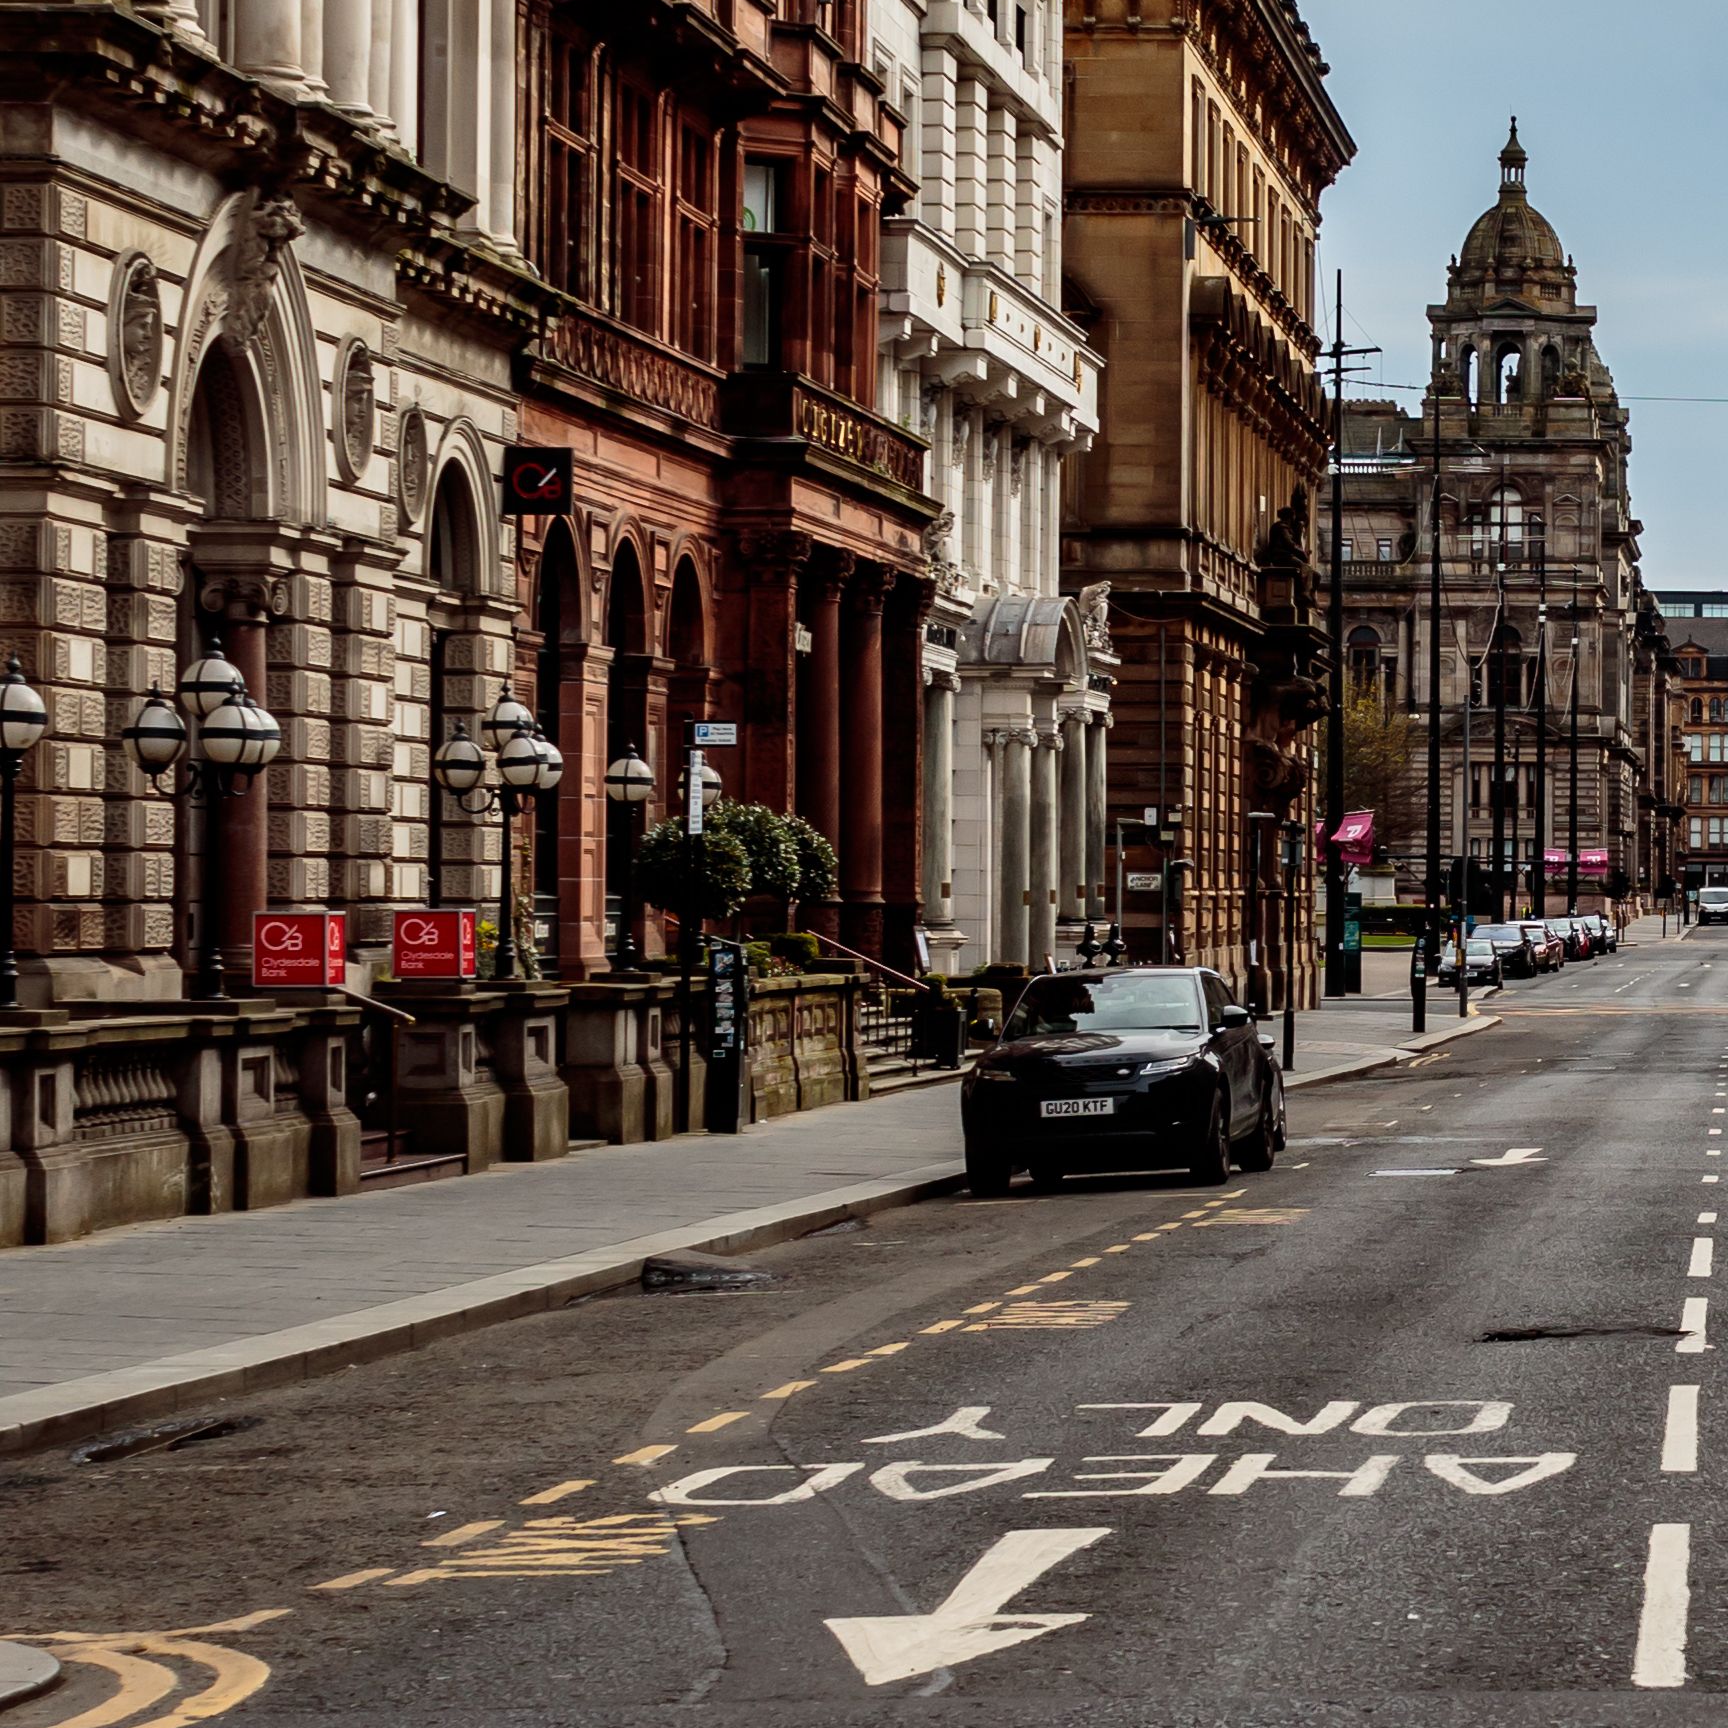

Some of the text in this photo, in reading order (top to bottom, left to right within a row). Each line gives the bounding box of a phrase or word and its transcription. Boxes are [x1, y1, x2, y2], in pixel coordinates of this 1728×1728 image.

[401, 951, 454, 962] Clydesdale
[261, 957, 320, 969] Clydesdale
[400, 960, 424, 969] Bank
[261, 968, 288, 977] Bank
[1045, 1100, 1108, 1115] GU20 KTF
[861, 1400, 1514, 1443] ONLY
[646, 1452, 1578, 1507] AHEAD
